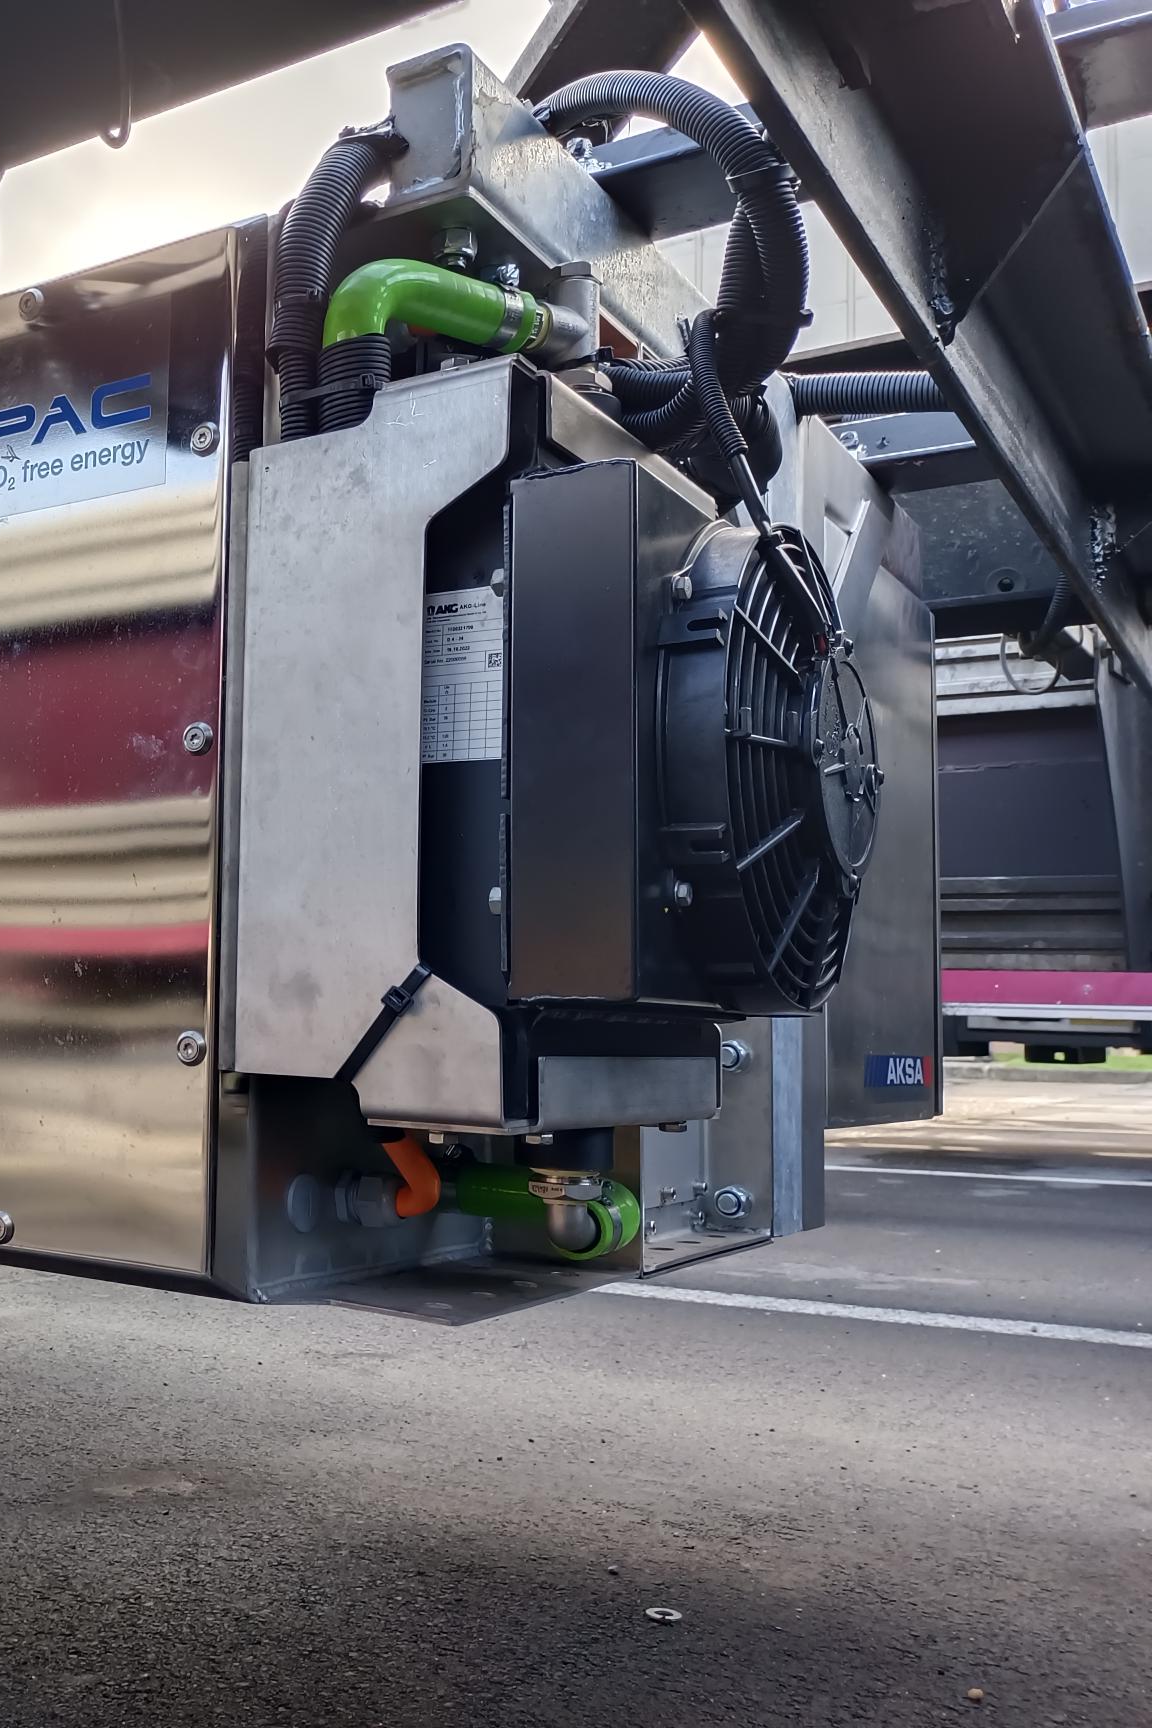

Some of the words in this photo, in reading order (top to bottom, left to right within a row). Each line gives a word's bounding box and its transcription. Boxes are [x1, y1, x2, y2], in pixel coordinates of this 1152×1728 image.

[22, 459, 64, 483] free
[70, 438, 150, 467] energy
[886, 1057, 924, 1085] AKSA
